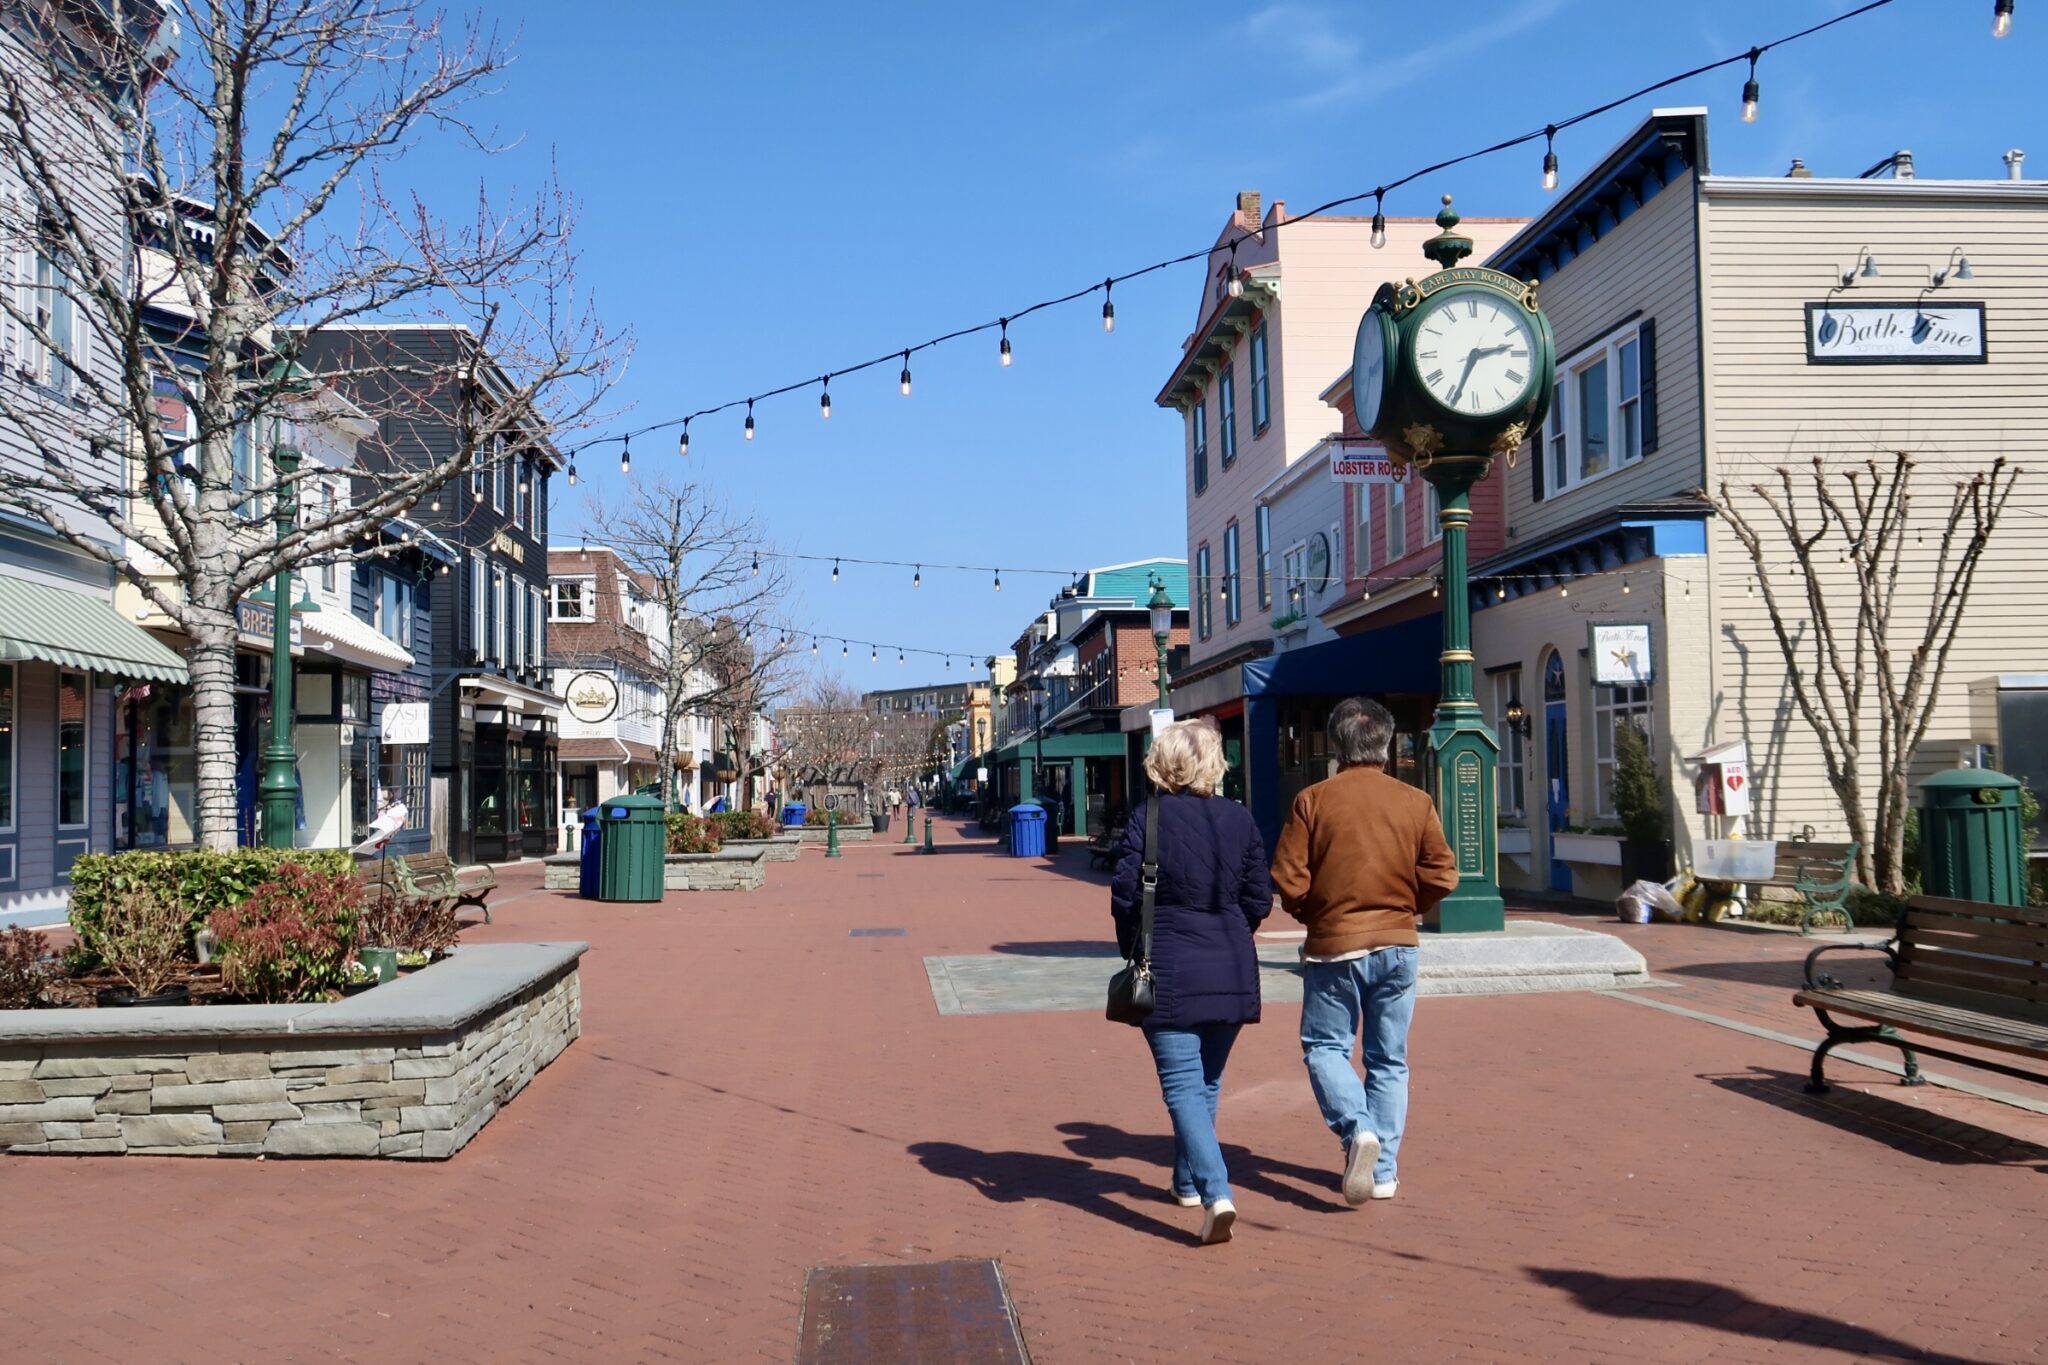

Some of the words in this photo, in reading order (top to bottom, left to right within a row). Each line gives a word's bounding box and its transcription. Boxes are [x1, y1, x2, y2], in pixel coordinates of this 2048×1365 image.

[1420, 273, 1449, 292] CAPE
[1451, 270, 1478, 281] MAY
[1480, 271, 1522, 295] ROTARY
[1820, 312, 1898, 349] Bath
[1333, 461, 1376, 475] LOBSTER
[384, 708, 427, 721] CASH
